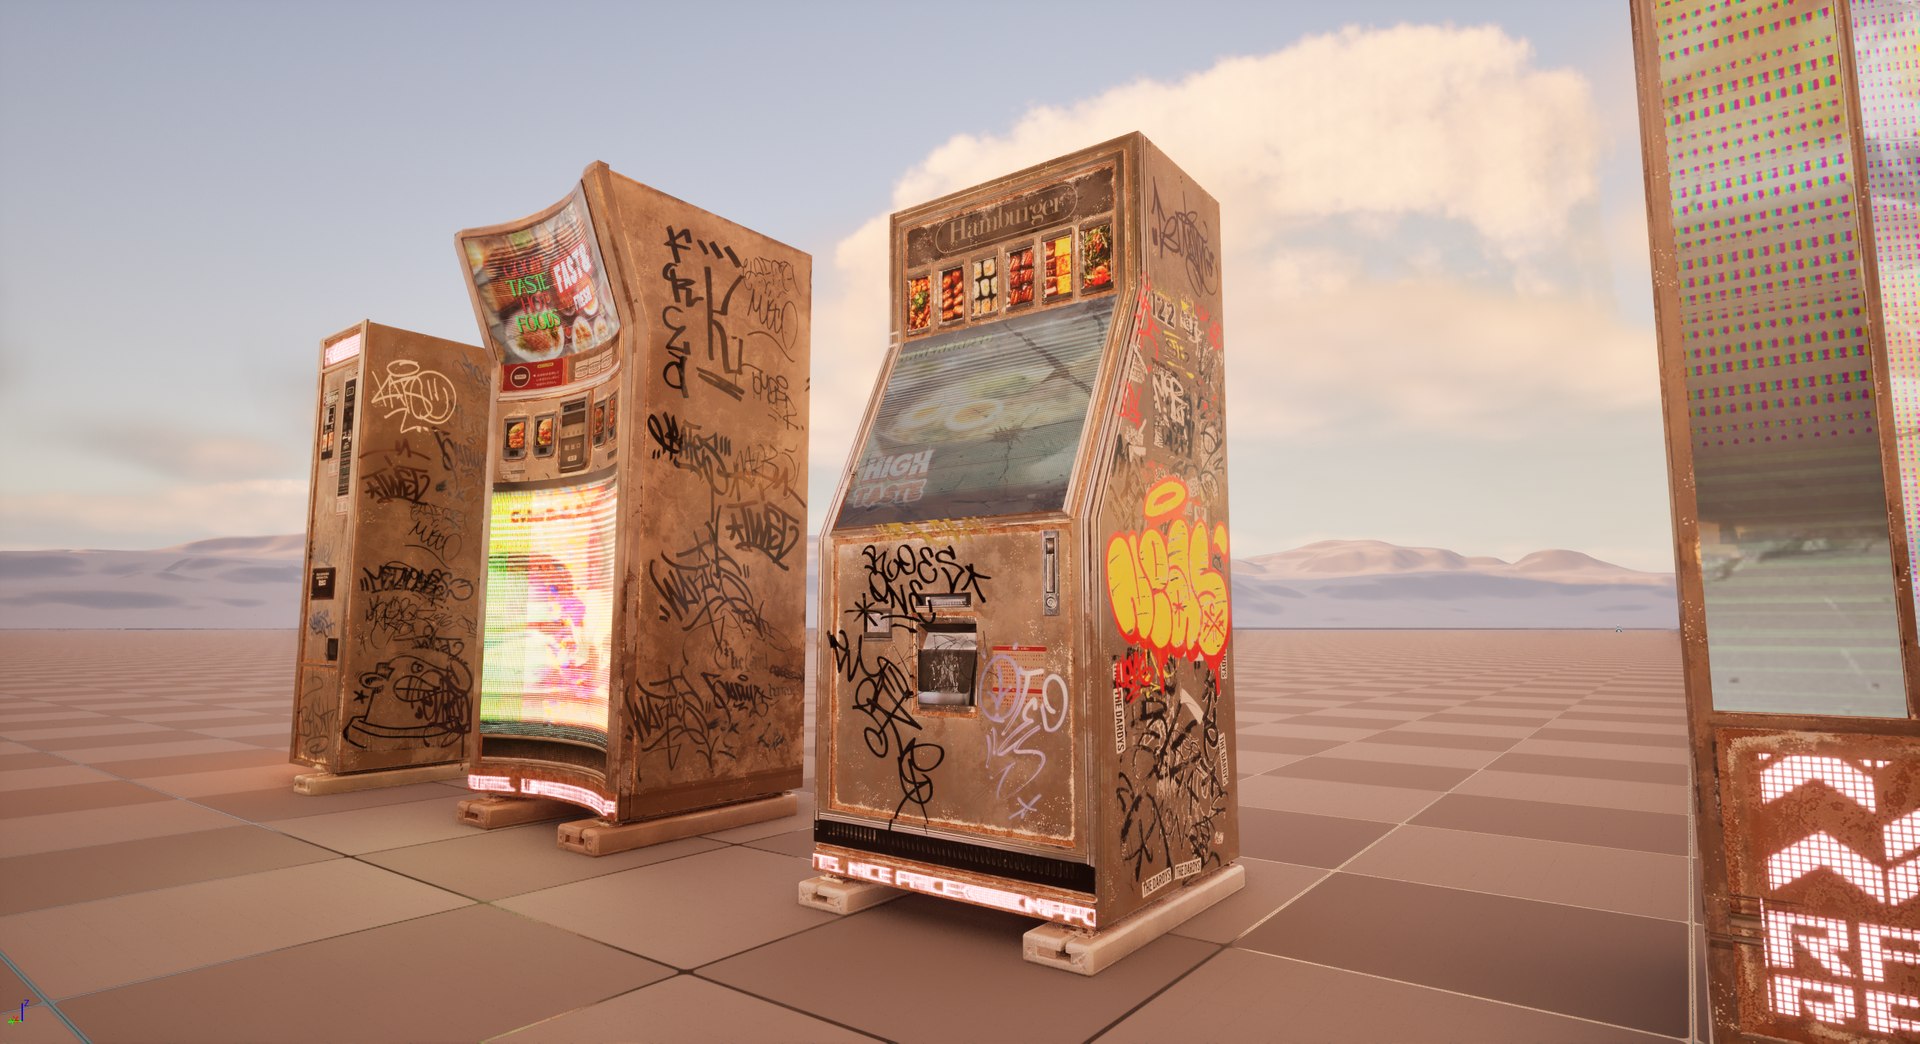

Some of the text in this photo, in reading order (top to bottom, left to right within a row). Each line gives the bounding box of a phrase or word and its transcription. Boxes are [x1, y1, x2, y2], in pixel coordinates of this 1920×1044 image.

[950, 195, 1065, 243] Hamburger
[862, 446, 936, 482] HIGH
[852, 479, 928, 509] TASTE
